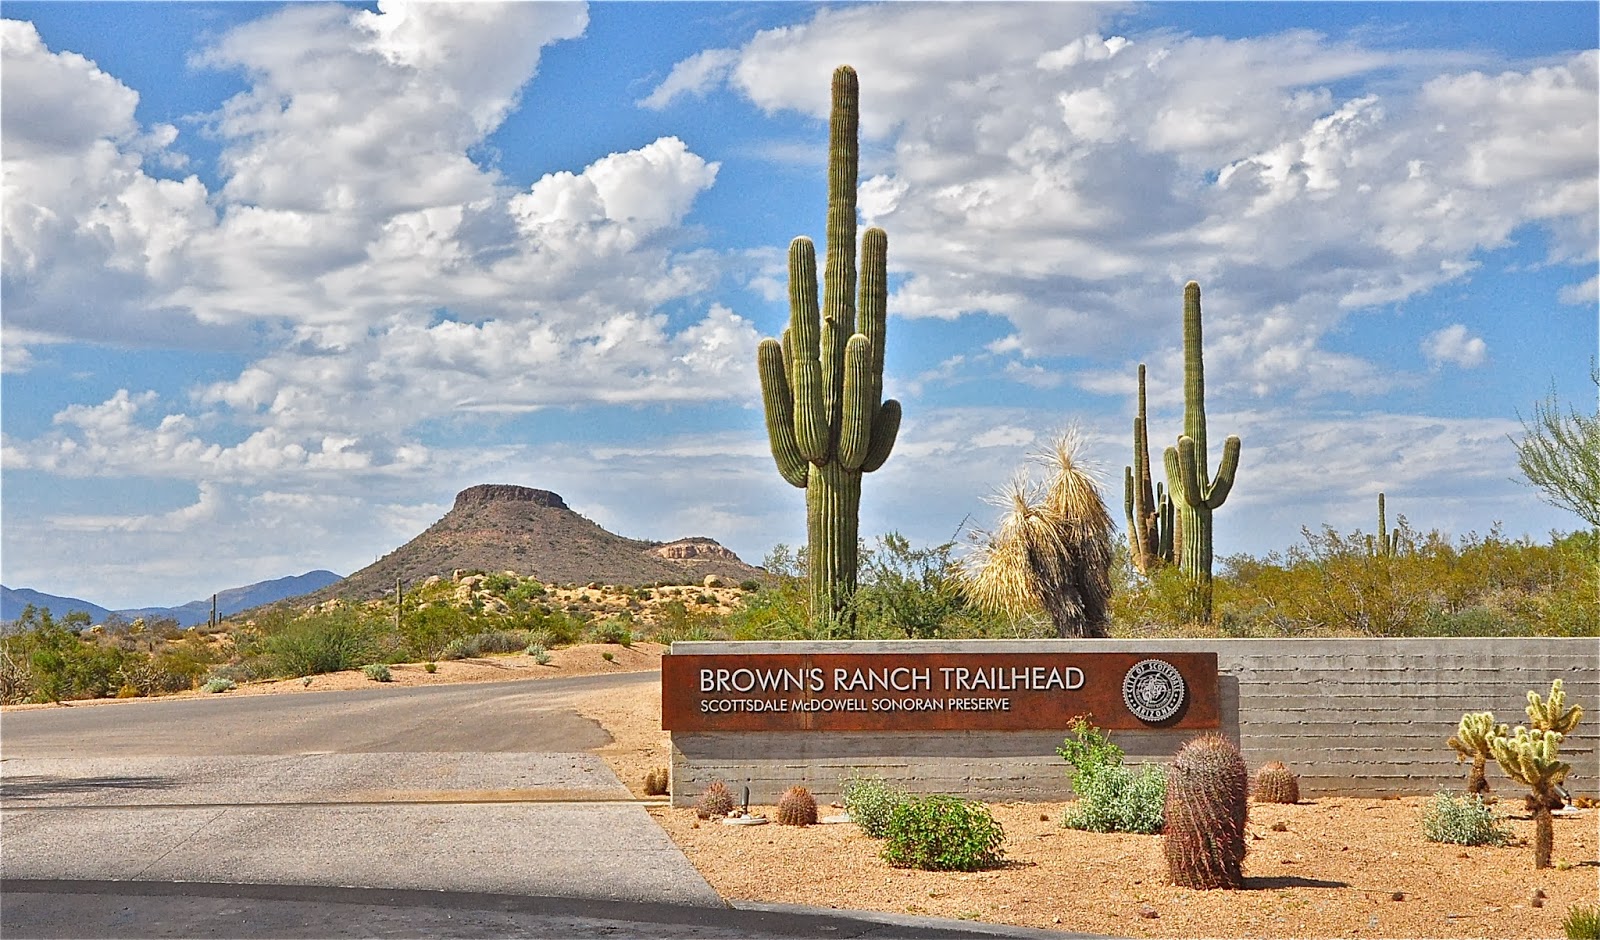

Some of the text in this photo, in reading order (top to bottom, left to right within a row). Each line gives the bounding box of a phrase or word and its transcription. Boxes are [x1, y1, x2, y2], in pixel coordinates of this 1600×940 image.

[700, 666, 1085, 692] BROWN'S RANCH TRAILHEAD
[1149, 663, 1181, 692] SCOTTSDALE
[700, 697, 1010, 712] SCOTTSDALE McDOWELL SONORAN PRESERVE
[1135, 706, 1172, 717] ARIZONA
